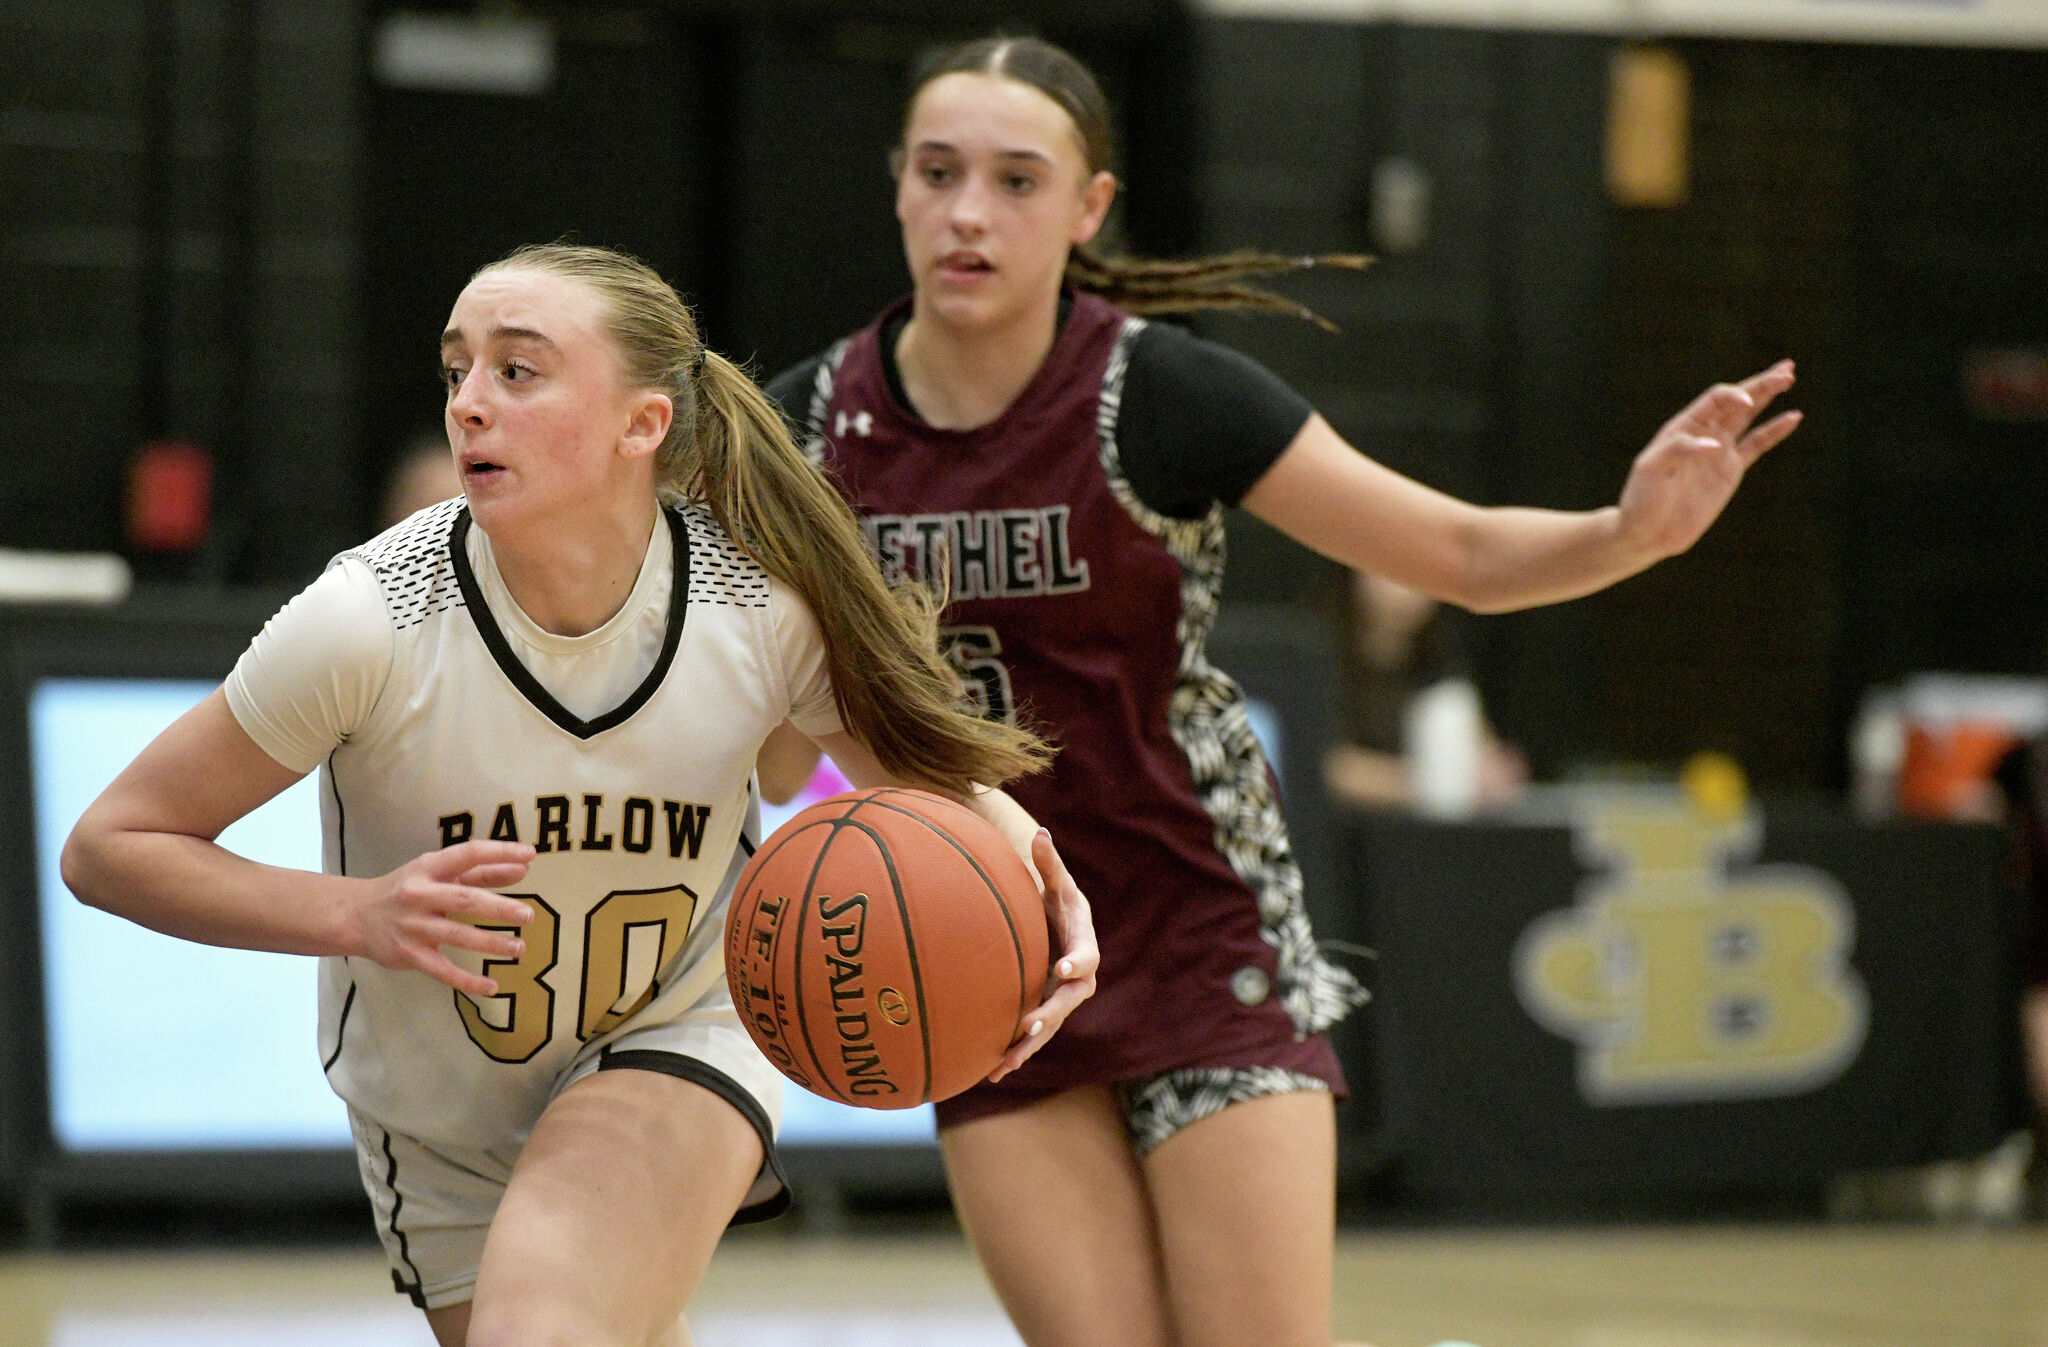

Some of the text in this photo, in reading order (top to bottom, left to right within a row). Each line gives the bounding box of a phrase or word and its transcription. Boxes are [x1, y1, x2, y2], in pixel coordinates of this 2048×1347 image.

[861, 505, 1091, 601] ETHEL
[447, 884, 698, 1065] 30
[819, 893, 899, 1097] SPALDING
